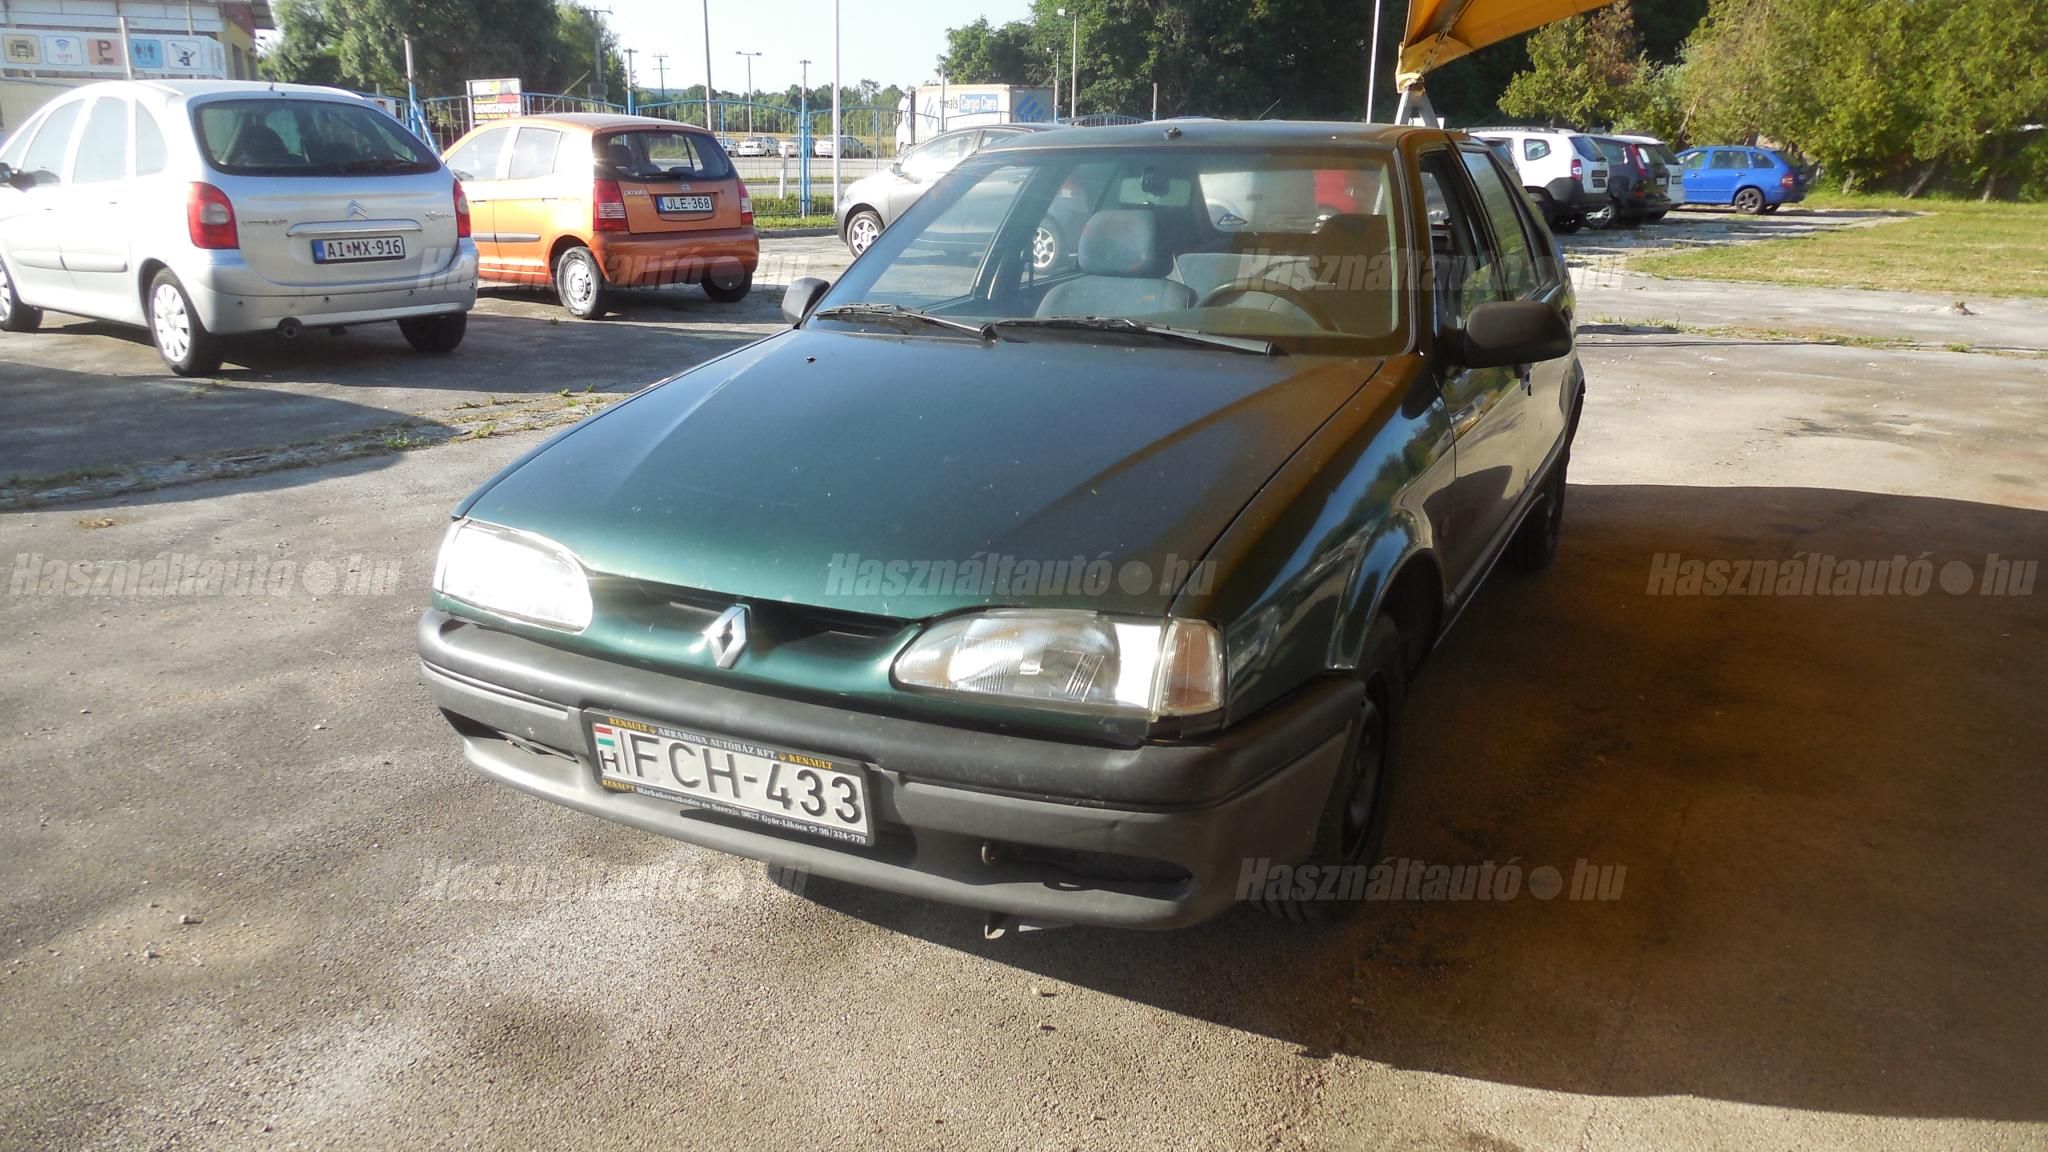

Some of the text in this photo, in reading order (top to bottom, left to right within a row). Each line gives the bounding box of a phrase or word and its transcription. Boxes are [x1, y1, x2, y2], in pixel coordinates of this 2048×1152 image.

[666, 197, 711, 210] JLE-368
[608, 716, 648, 732] RENAULT
[658, 727, 708, 745] ARRABONA
[788, 753, 833, 770] RENAULT
[599, 749, 621, 773] H
[602, 778, 636, 793] RENAULT
[629, 733, 863, 824] FCH-433
